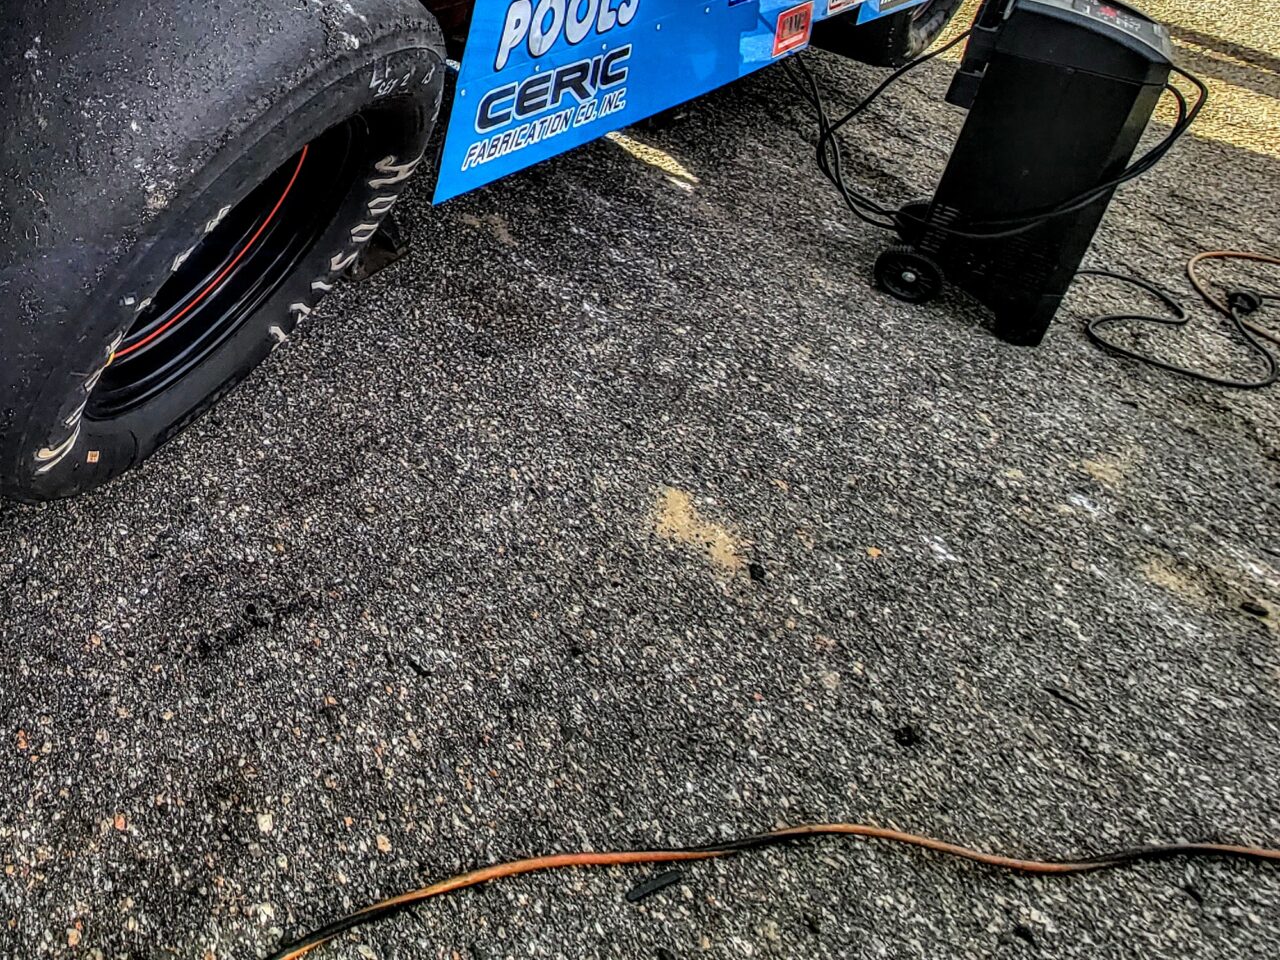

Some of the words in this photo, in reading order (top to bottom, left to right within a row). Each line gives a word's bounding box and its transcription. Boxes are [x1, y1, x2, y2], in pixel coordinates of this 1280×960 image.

[461, 106, 574, 171] FABRICATION
[572, 98, 598, 128] CO.
[596, 88, 627, 120] INC.
[475, 44, 632, 133] CERIC
